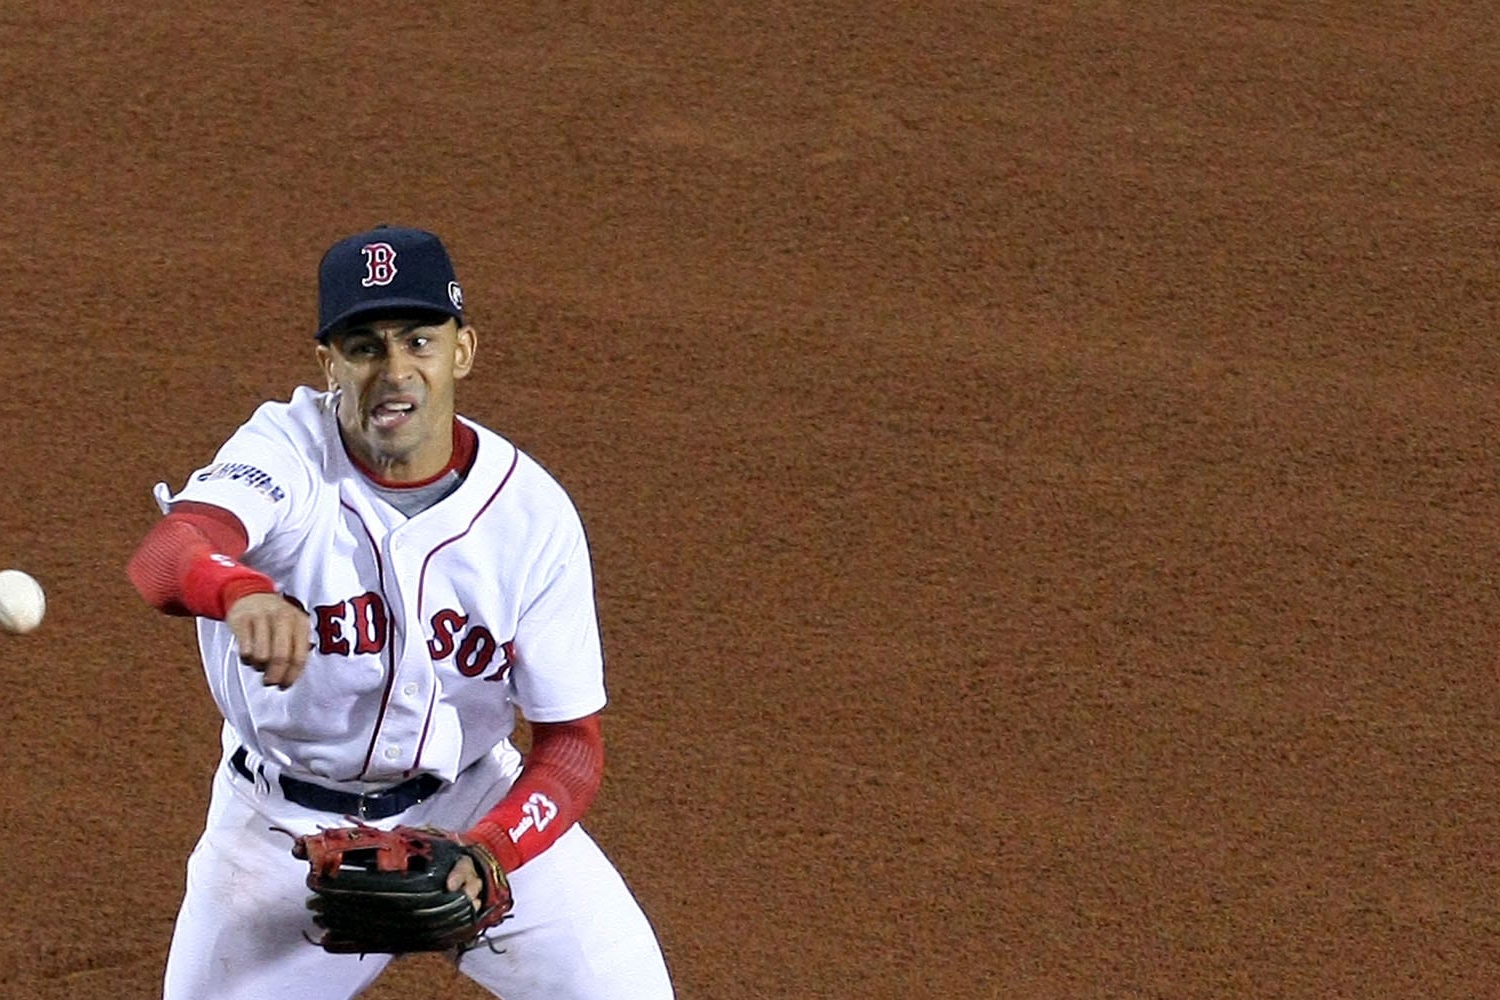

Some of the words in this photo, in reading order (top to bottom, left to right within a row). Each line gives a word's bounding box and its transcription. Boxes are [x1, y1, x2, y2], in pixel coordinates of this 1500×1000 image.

[361, 242, 398, 287] B
[313, 591, 388, 656] ED
[522, 792, 558, 832] 23
